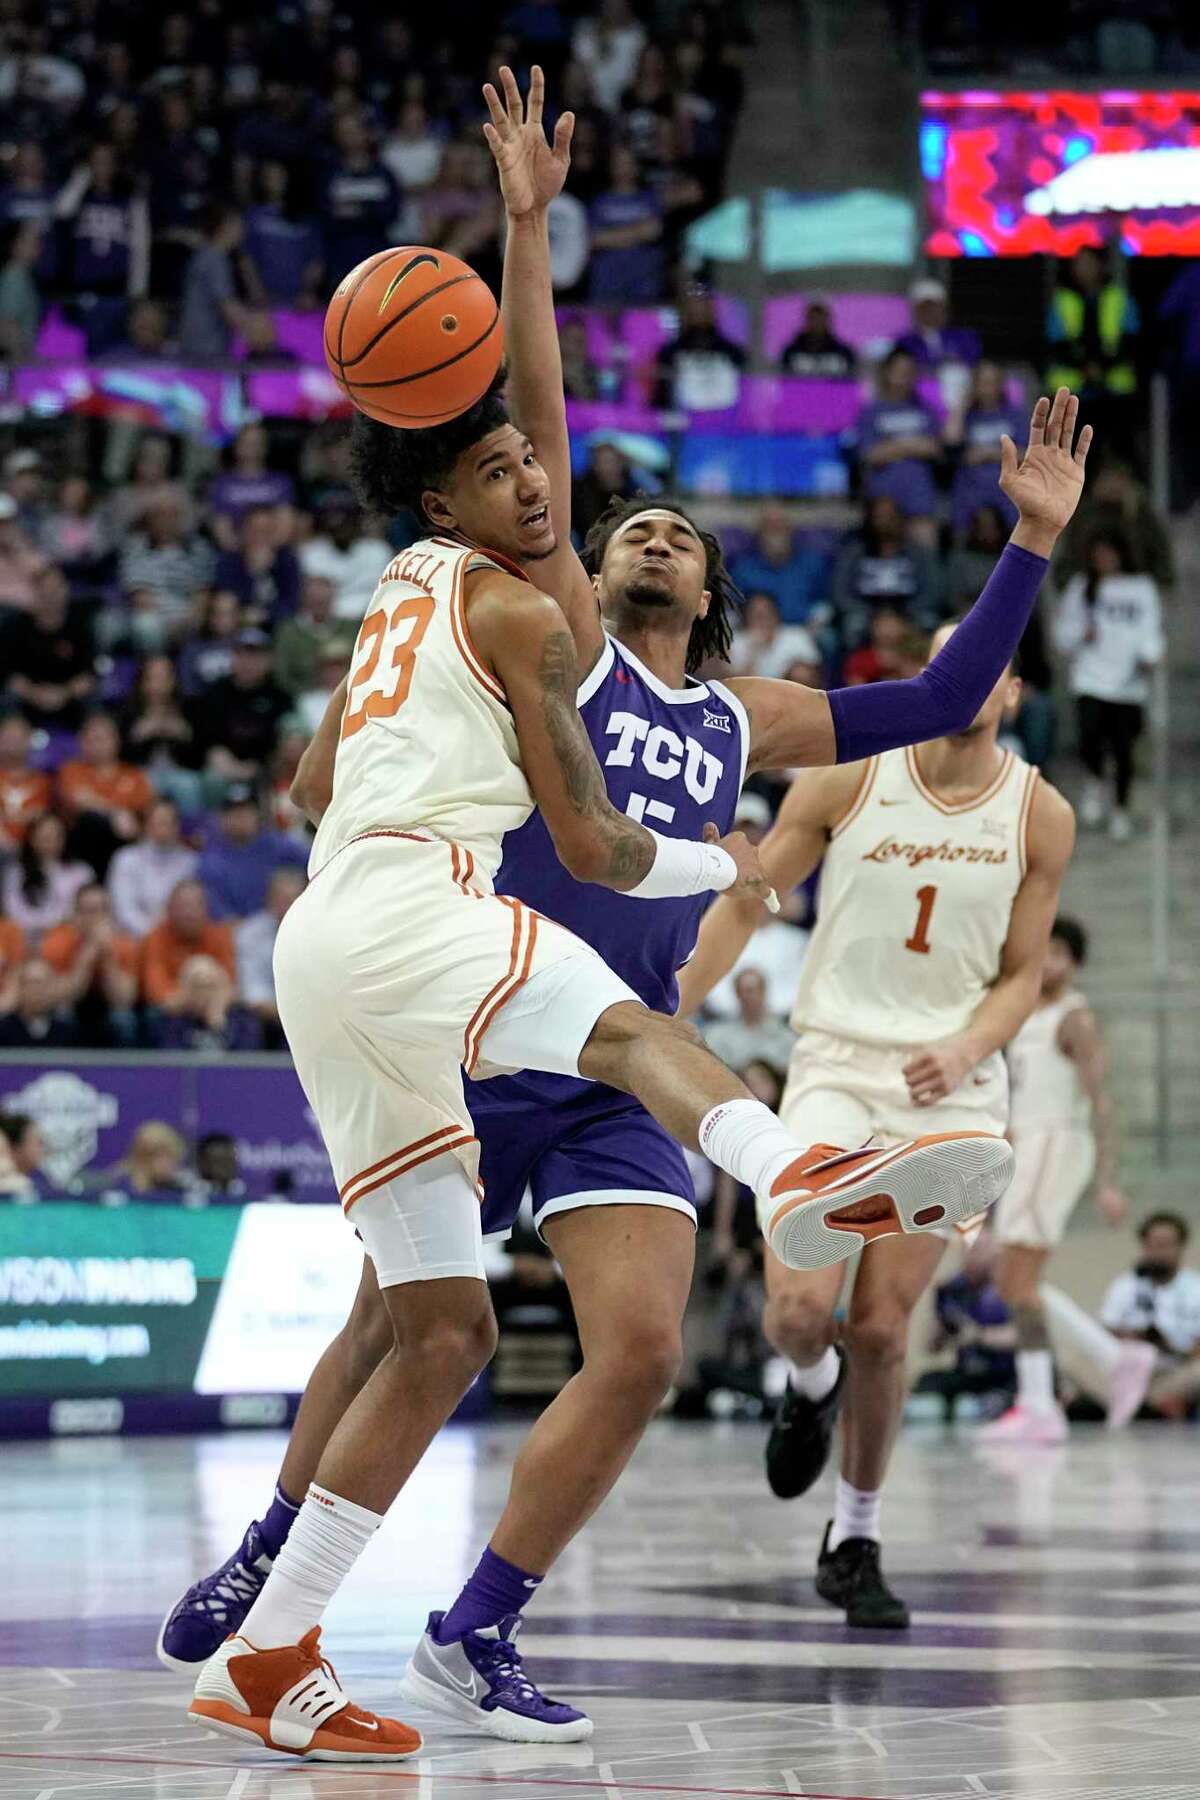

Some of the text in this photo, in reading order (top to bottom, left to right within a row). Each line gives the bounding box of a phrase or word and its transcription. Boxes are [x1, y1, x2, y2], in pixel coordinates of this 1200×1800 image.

[341, 596, 437, 742] 23
[604, 711, 724, 806] TCU
[861, 834, 1009, 867] Longhorns
[904, 884, 938, 955] 1
